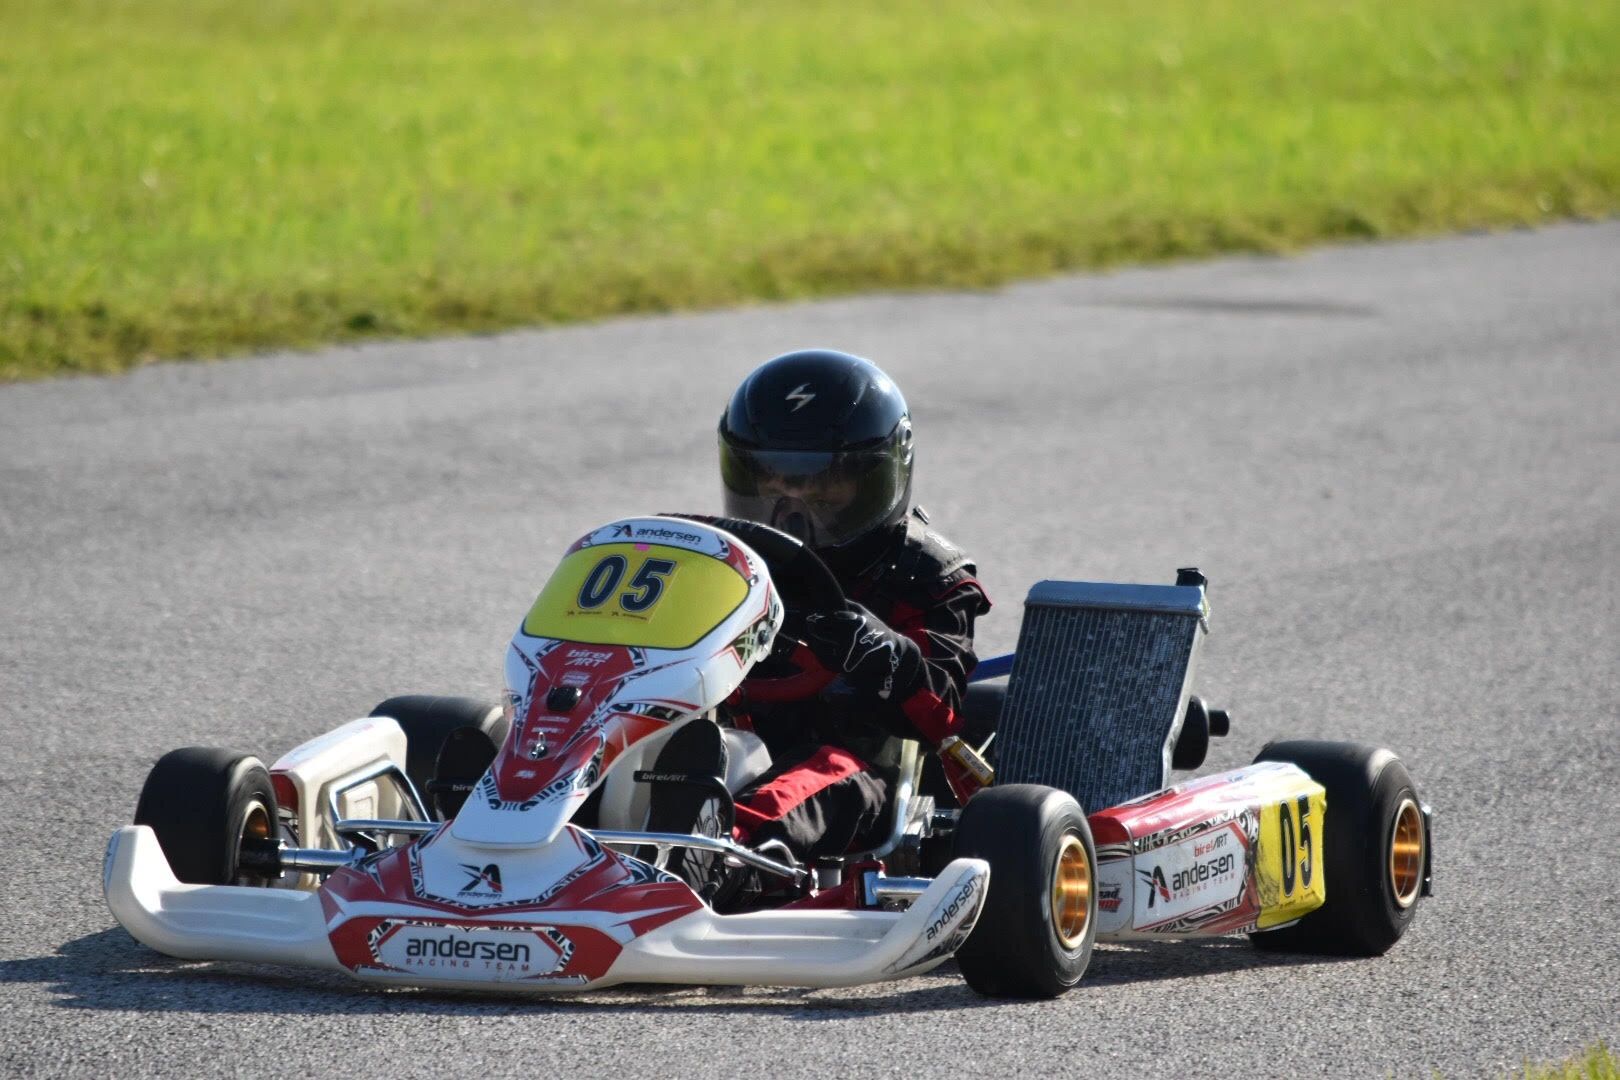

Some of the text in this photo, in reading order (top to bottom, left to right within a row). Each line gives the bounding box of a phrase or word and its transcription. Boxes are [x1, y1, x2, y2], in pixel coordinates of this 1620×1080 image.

[636, 528, 702, 542] andersen
[577, 555, 677, 612] 05
[565, 658, 606, 667] ART
[566, 650, 614, 660] birel
[1279, 795, 1313, 897] 05
[1172, 853, 1234, 891] andersen
[926, 875, 978, 940] andersen
[406, 934, 530, 962] andersen
[406, 958, 530, 971] RACING TEAM
